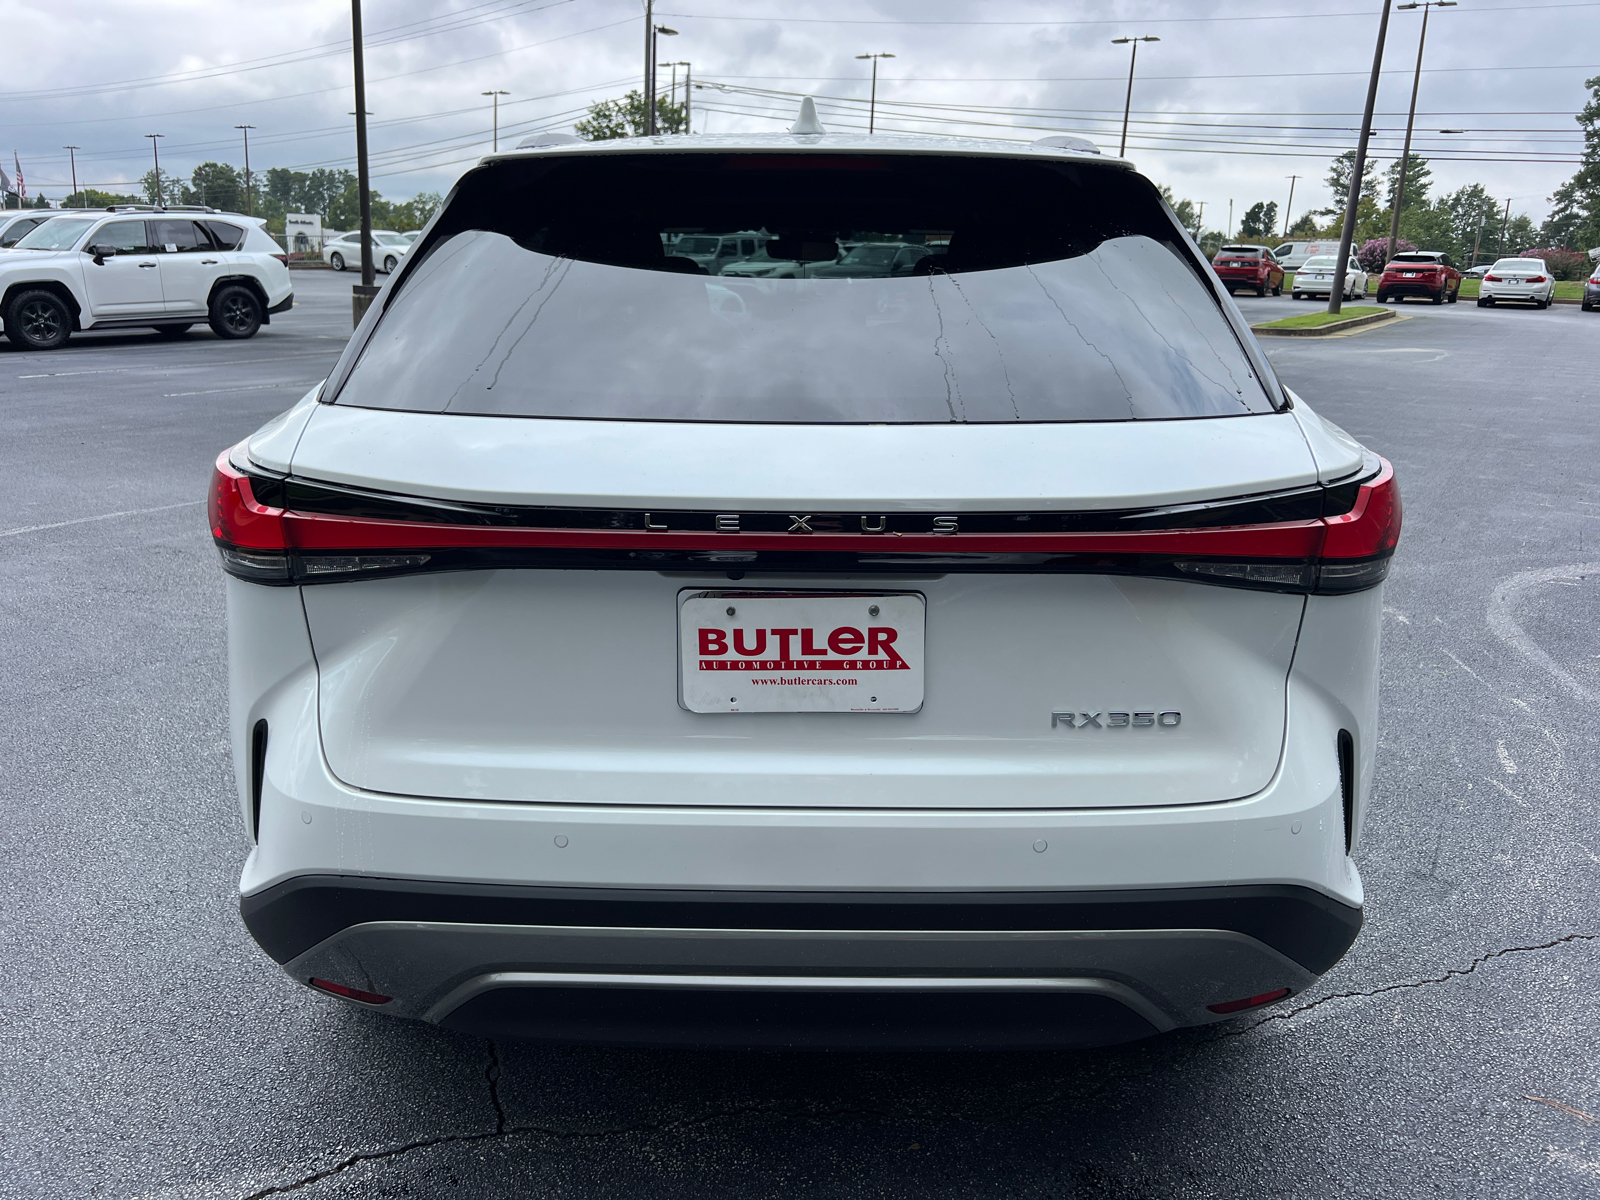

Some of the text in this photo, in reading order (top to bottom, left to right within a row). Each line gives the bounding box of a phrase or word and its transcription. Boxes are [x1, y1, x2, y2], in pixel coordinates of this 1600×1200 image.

[644, 513, 960, 532] LEXUS
[700, 660, 903, 670] AUTOMOTIVE GROUP
[751, 676, 858, 686] www.butlercars.com
